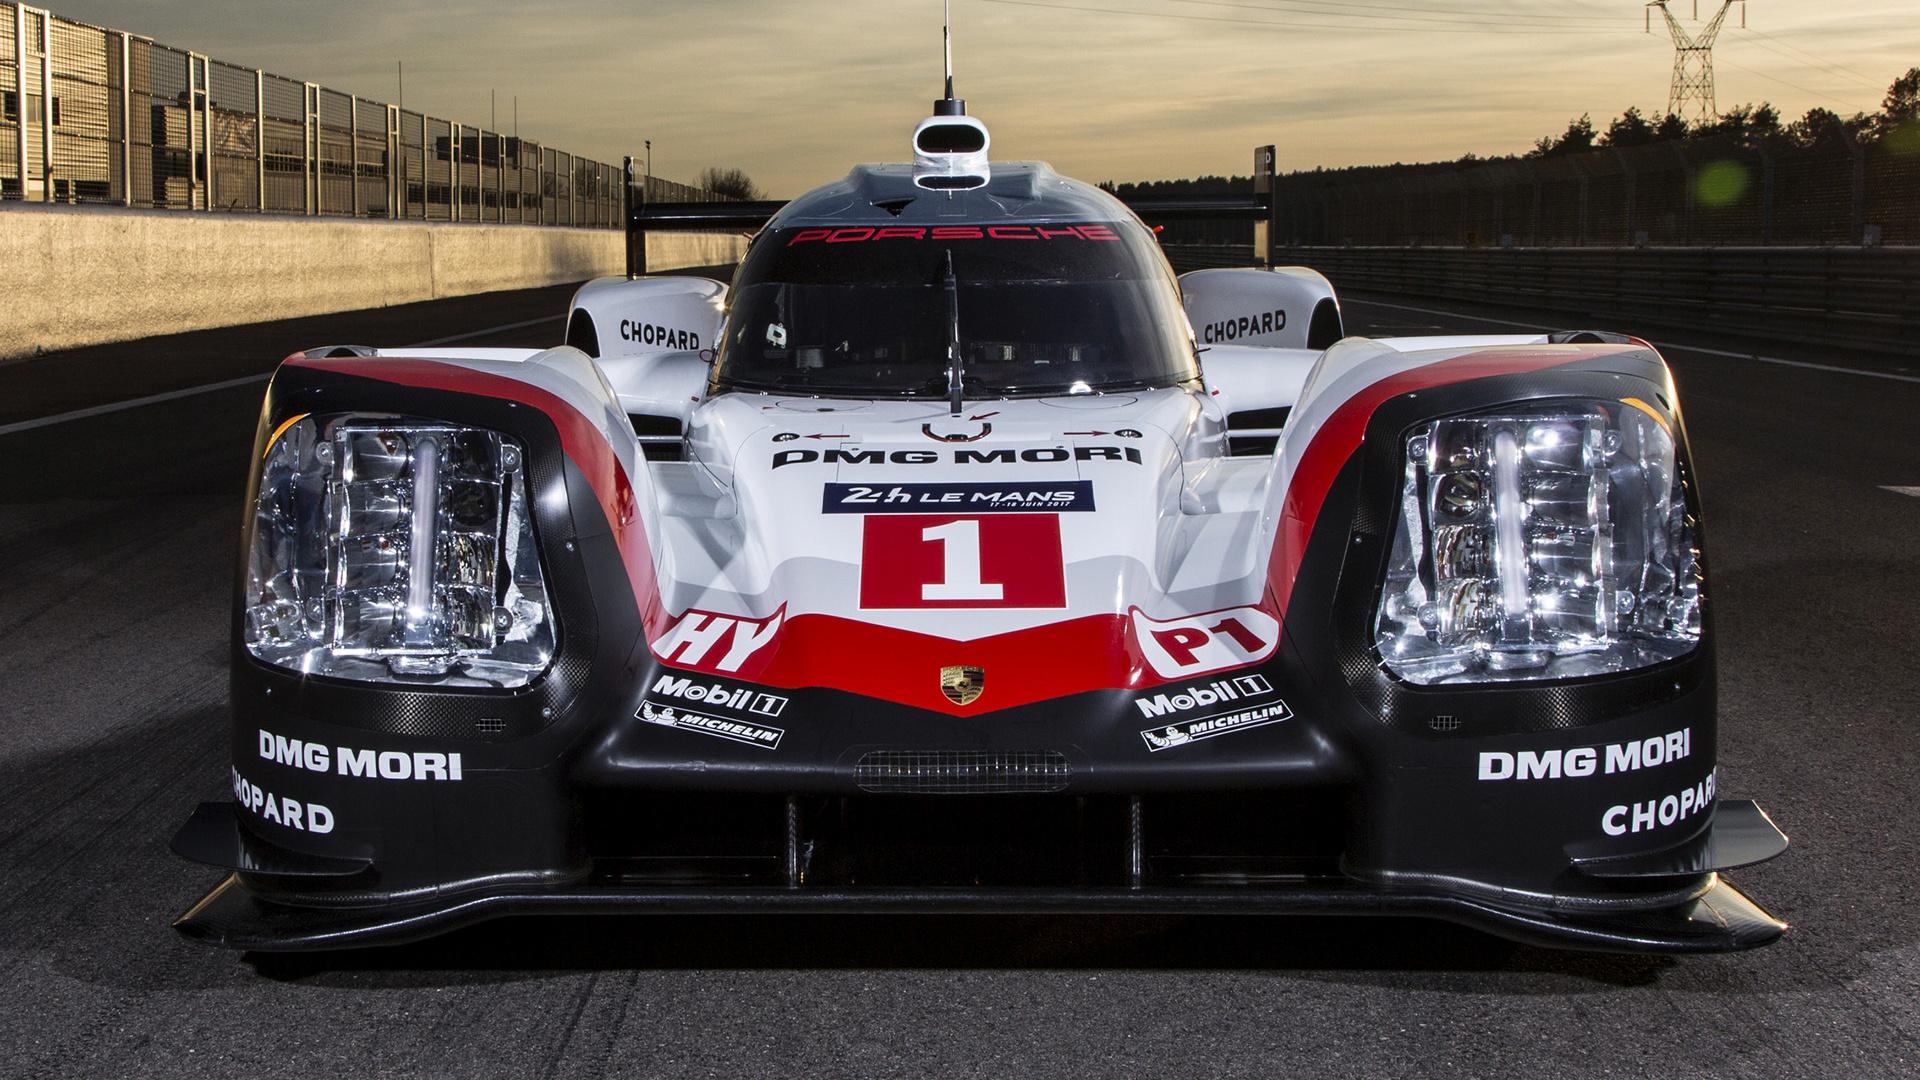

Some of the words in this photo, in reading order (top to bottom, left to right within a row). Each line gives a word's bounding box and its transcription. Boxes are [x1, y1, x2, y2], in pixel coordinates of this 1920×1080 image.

[787, 226, 1121, 246] PORSCHE
[620, 319, 700, 350] CHOPARD
[1204, 309, 1287, 344] CHOPARD
[772, 449, 938, 470] DMG
[954, 446, 1142, 466] MORI
[919, 493, 965, 503] LE
[970, 492, 1075, 502] MANS
[922, 520, 1004, 600] 1
[651, 611, 783, 673] HY
[1150, 617, 1267, 667] P1
[652, 675, 753, 710] Mobil
[763, 697, 776, 712] 1
[1135, 681, 1238, 718] Mobil
[1243, 678, 1261, 691] 1
[680, 714, 778, 742] MICHELIN
[1190, 705, 1283, 734] MICHELIN
[259, 729, 330, 772] DMG
[337, 747, 462, 780] MORI
[1478, 748, 1597, 780] DMG
[1605, 728, 1690, 774] MORI
